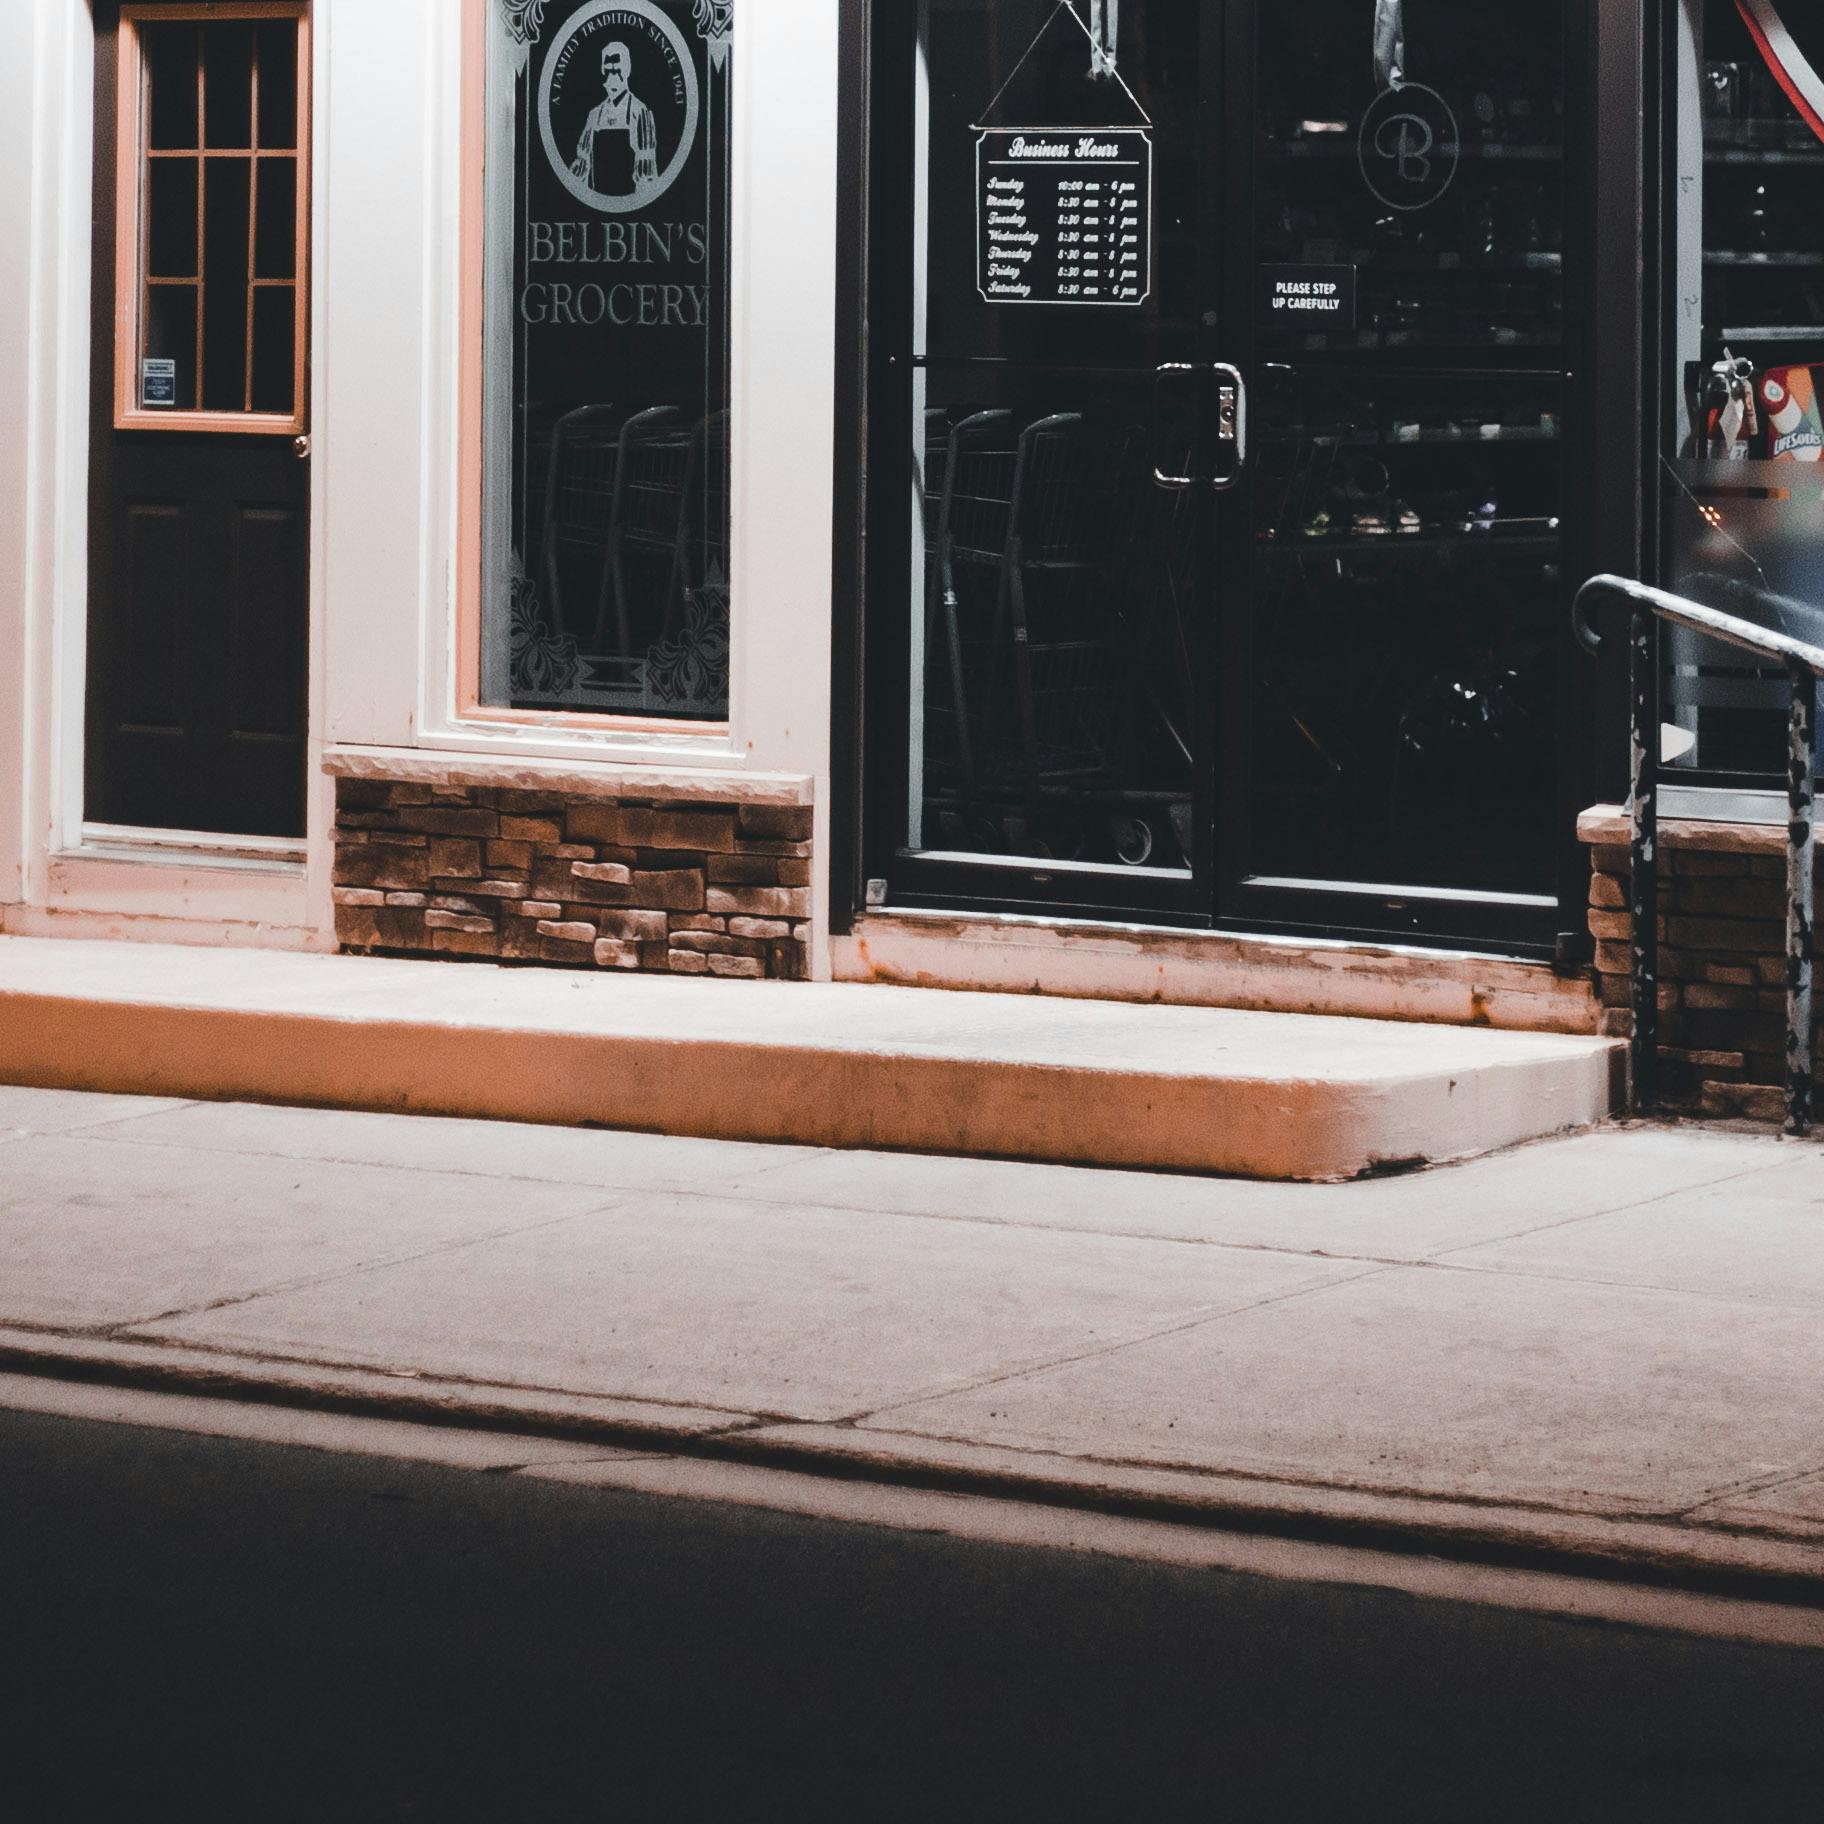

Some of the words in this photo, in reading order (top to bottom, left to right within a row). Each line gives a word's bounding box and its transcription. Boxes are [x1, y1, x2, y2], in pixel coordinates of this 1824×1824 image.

[553, 36, 580, 89] FAMILY
[582, 12, 646, 38] TRADITION
[648, 26, 678, 68] SINCE
[1008, 137, 1070, 158] Business
[1075, 137, 1118, 158] Hours
[987, 176, 1024, 193] Sunday
[1118, 183, 1135, 194] pm
[986, 194, 1024, 210] Monday
[1120, 200, 1137, 211] pm
[987, 212, 1026, 228] Tuesday
[1083, 217, 1099, 225] am
[1120, 218, 1137, 229] pm
[529, 221, 707, 264] BELBIN'S
[987, 230, 1039, 246] Wednesday
[1120, 235, 1137, 246] pm
[987, 246, 1032, 263] Thursday
[1120, 253, 1137, 264] pm
[987, 263, 1020, 280] Friday
[1120, 270, 1137, 281] pm
[988, 281, 1031, 297] Saturday
[1120, 288, 1137, 299] pm
[1276, 282, 1310, 294] PLEASE
[1313, 283, 1336, 294] STEP
[520, 283, 711, 327] GROCERY
[1273, 298, 1285, 308] UP
[1288, 298, 1339, 309] CAREFULLY
